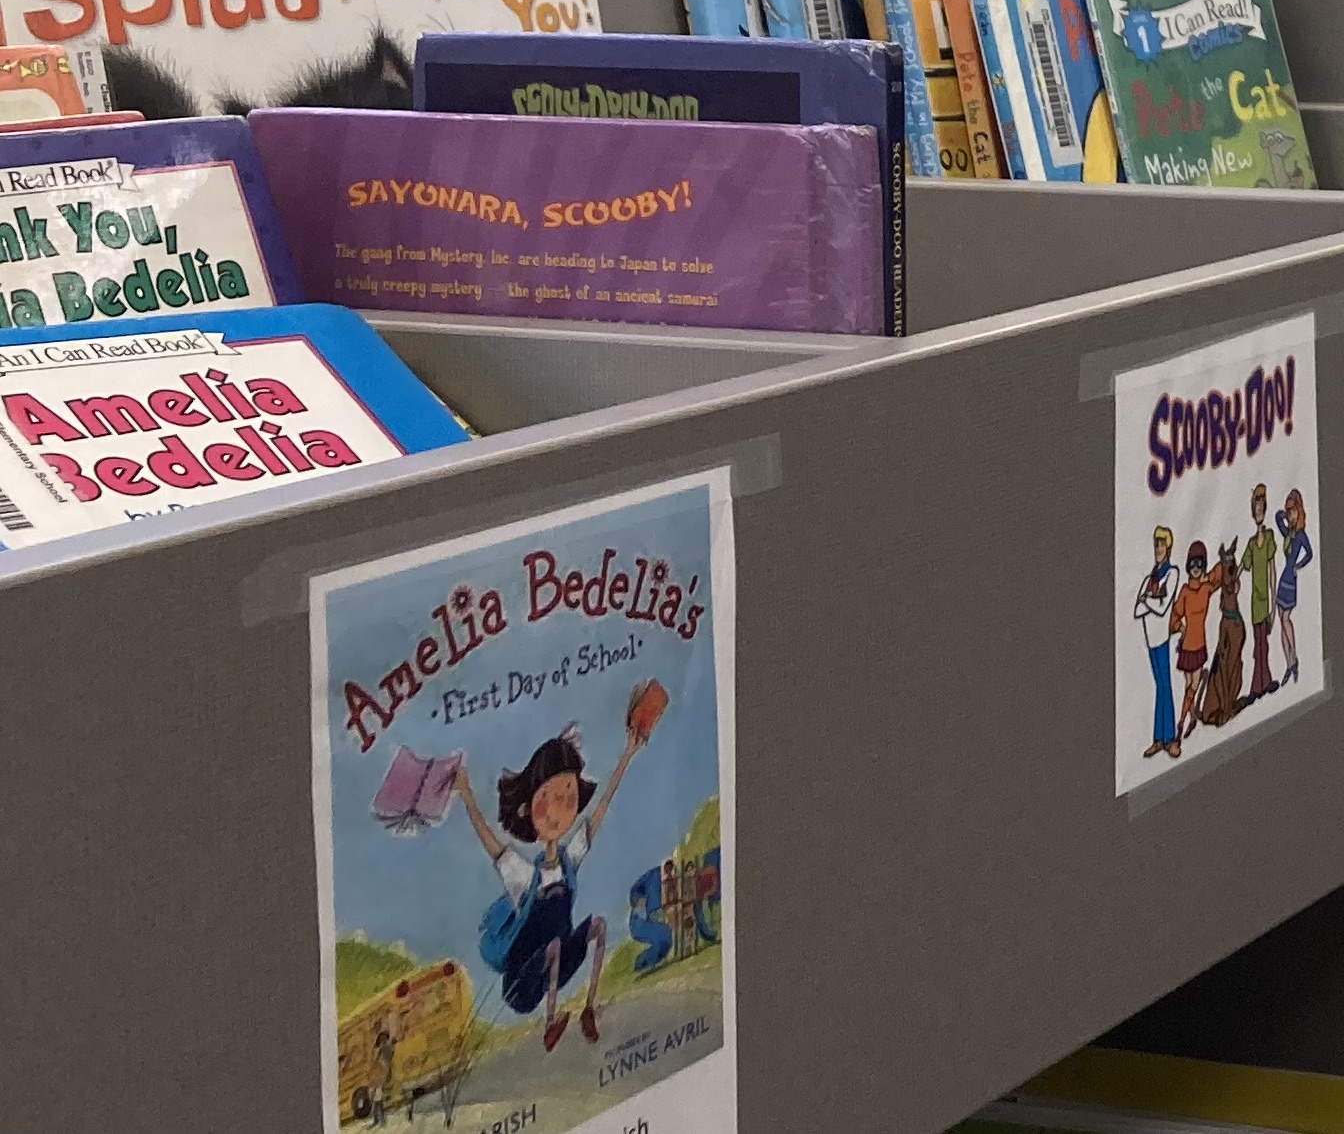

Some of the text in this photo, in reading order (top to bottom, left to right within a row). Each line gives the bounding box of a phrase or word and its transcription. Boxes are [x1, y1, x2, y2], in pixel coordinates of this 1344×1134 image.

[1137, 25, 1150, 53] 1
[1164, 17, 1175, 41] I
[1175, 11, 1206, 38] Can
[1131, 68, 1288, 141] Pete the Cat
[972, 131, 991, 166] Cat
[1144, 145, 1254, 187] Making New
[8, 161, 114, 192] Read Book
[892, 141, 902, 260] SCOOBY-DOO
[57, 201, 178, 255] You,
[347, 179, 694, 231] SAYONARA, SCOOBY!
[52, 248, 250, 323] Bedelia
[361, 248, 392, 266] gang
[396, 245, 427, 262] from
[518, 252, 540, 267] are
[544, 251, 596, 274] heading
[601, 255, 617, 271] to
[619, 254, 658, 276] Japan
[662, 256, 677, 273] to
[346, 274, 378, 296] truly
[382, 278, 427, 299] creepy
[431, 281, 484, 302] mystery
[507, 280, 530, 298] the
[535, 282, 571, 304] ghost
[576, 283, 590, 301] of
[595, 288, 612, 303] an
[614, 288, 662, 305] ancient
[667, 291, 719, 308] samurai
[44, 346, 91, 364] Can
[88, 339, 148, 359] Read
[144, 333, 205, 354] Book
[1, 367, 309, 446] Amelia
[1147, 355, 1296, 497] SCOOBY-DOO!
[40, 420, 363, 503] Bedelia
[344, 548, 705, 754] Amelia Bedelia's
[442, 635, 637, 726] First Day of School
[598, 1040, 659, 1087] LYNNE
[663, 1016, 711, 1055] AVRIL
